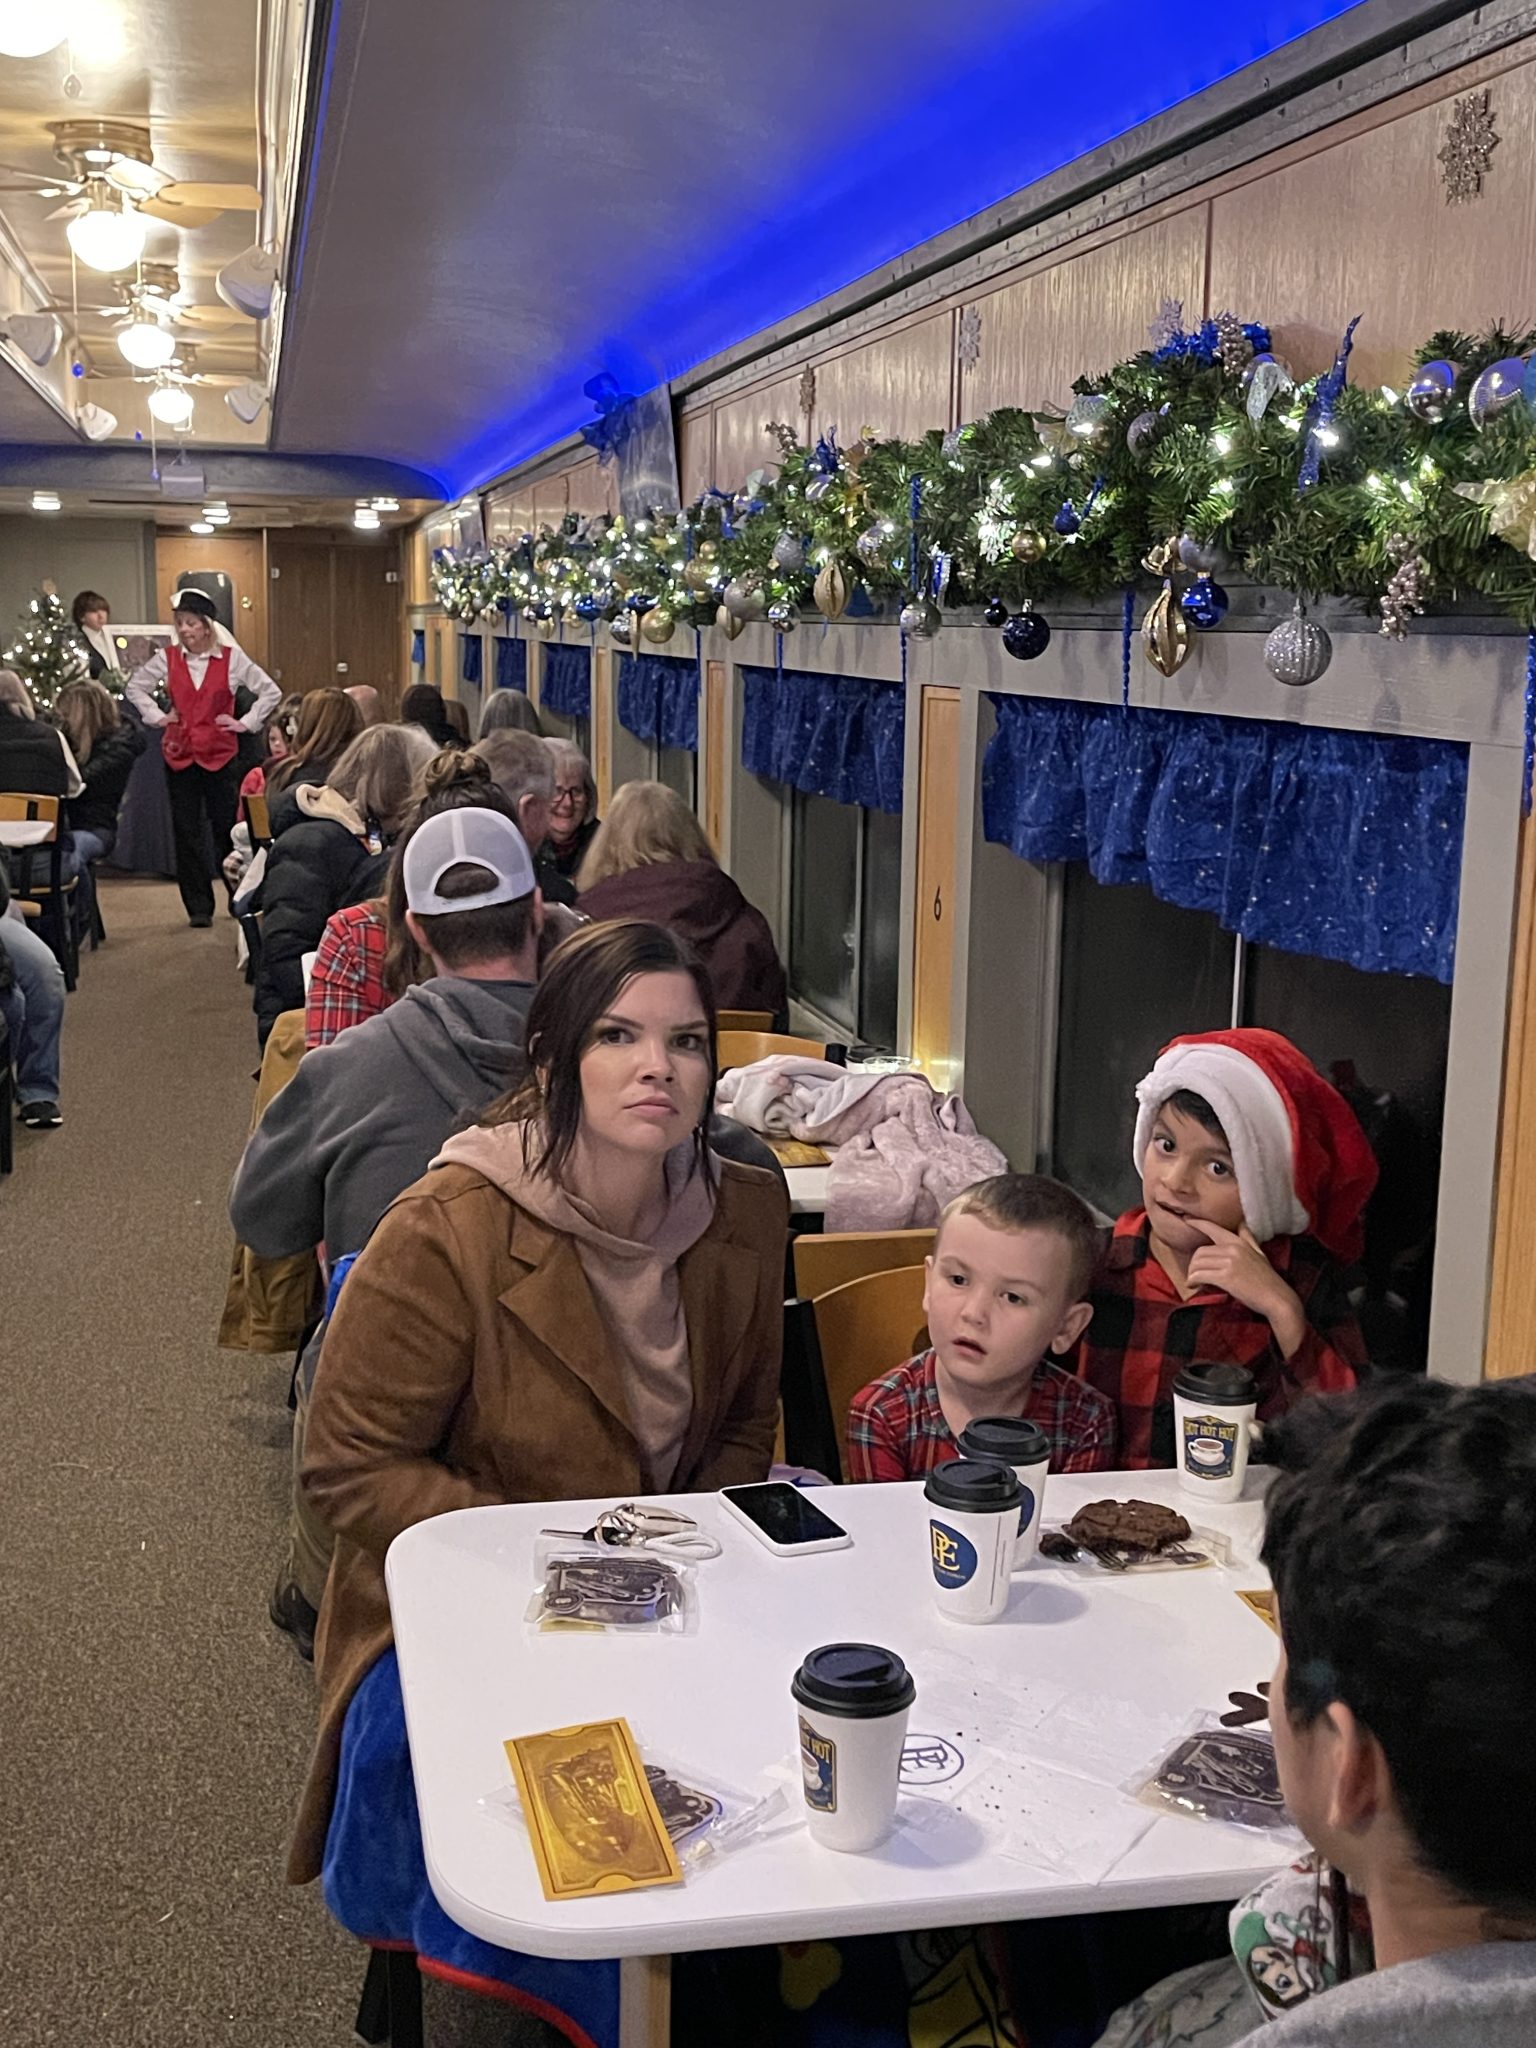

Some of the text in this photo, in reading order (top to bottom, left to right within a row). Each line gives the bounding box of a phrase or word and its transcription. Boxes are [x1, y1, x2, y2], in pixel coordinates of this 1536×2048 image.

[933, 885, 942, 922] 6
[1200, 1425, 1217, 1438] HOT
[1218, 1427, 1235, 1441] HOT
[811, 1738, 831, 1764] HOT
